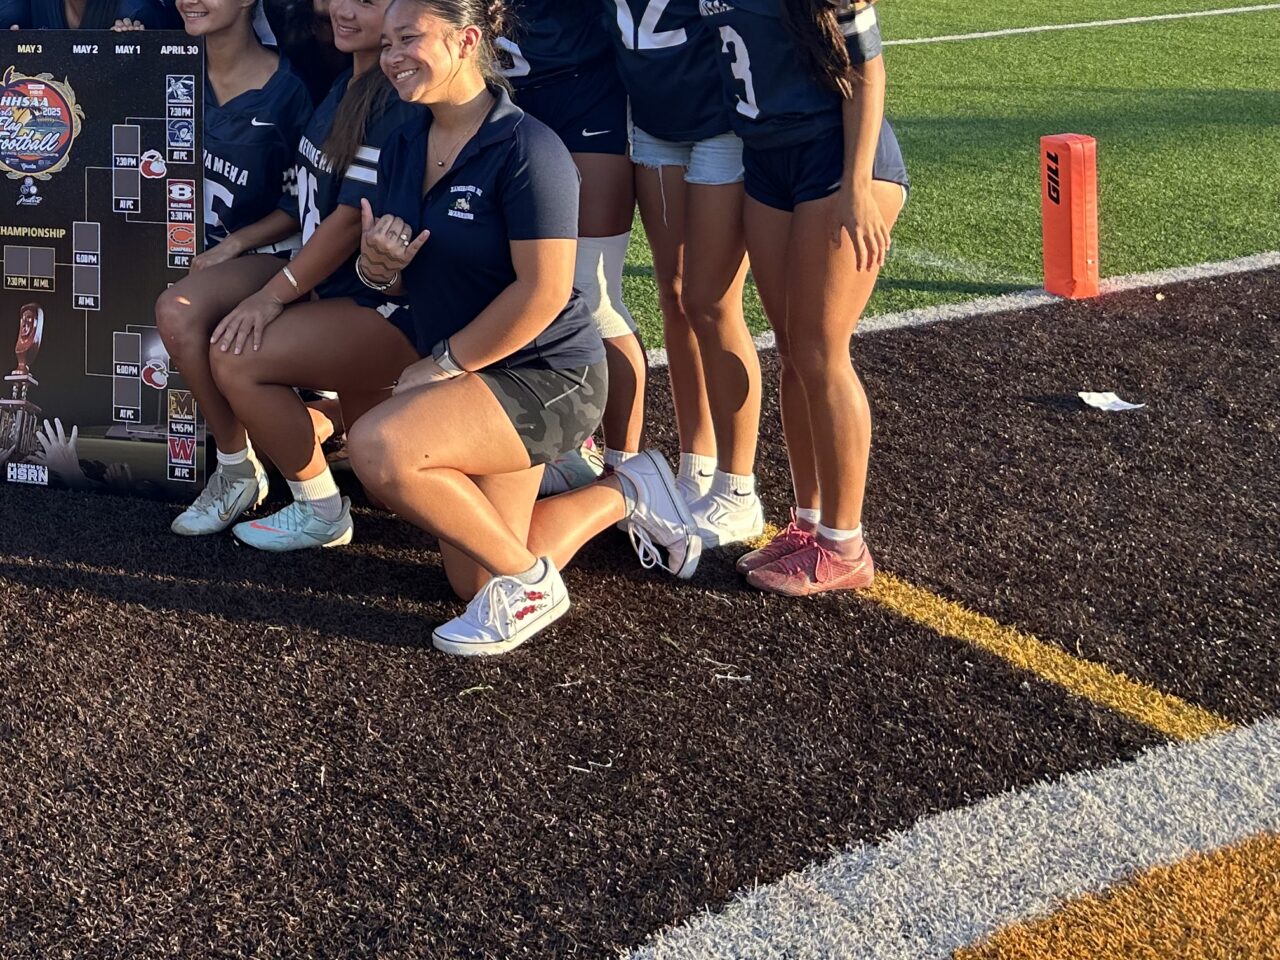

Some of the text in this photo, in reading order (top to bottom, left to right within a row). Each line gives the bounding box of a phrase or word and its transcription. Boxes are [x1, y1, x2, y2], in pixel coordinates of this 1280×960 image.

[17, 45, 42, 53] MAY 3
[73, 45, 98, 54] MAY 2
[115, 46, 134, 54] MAY
[160, 46, 198, 54] APRIL 30
[0, 96, 49, 107] HHSAA
[42, 108, 61, 116] 2025
[182, 108, 190, 116] PM
[180, 152, 188, 160] PC
[127, 158, 136, 166] PM
[1046, 151, 1061, 205] GILL
[169, 184, 192, 200] B
[126, 200, 134, 209] PC
[182, 212, 192, 220] PM
[88, 254, 97, 264] PM
[182, 257, 188, 266] PC
[7, 276, 26, 286] 7:30 PM
[34, 278, 40, 286] AT
[129, 366, 138, 375] PM
[120, 409, 134, 419] AT PC
[184, 424, 194, 433] PM
[168, 437, 195, 460] W
[7, 466, 48, 482] HSRN
[174, 468, 190, 478] AT PC
